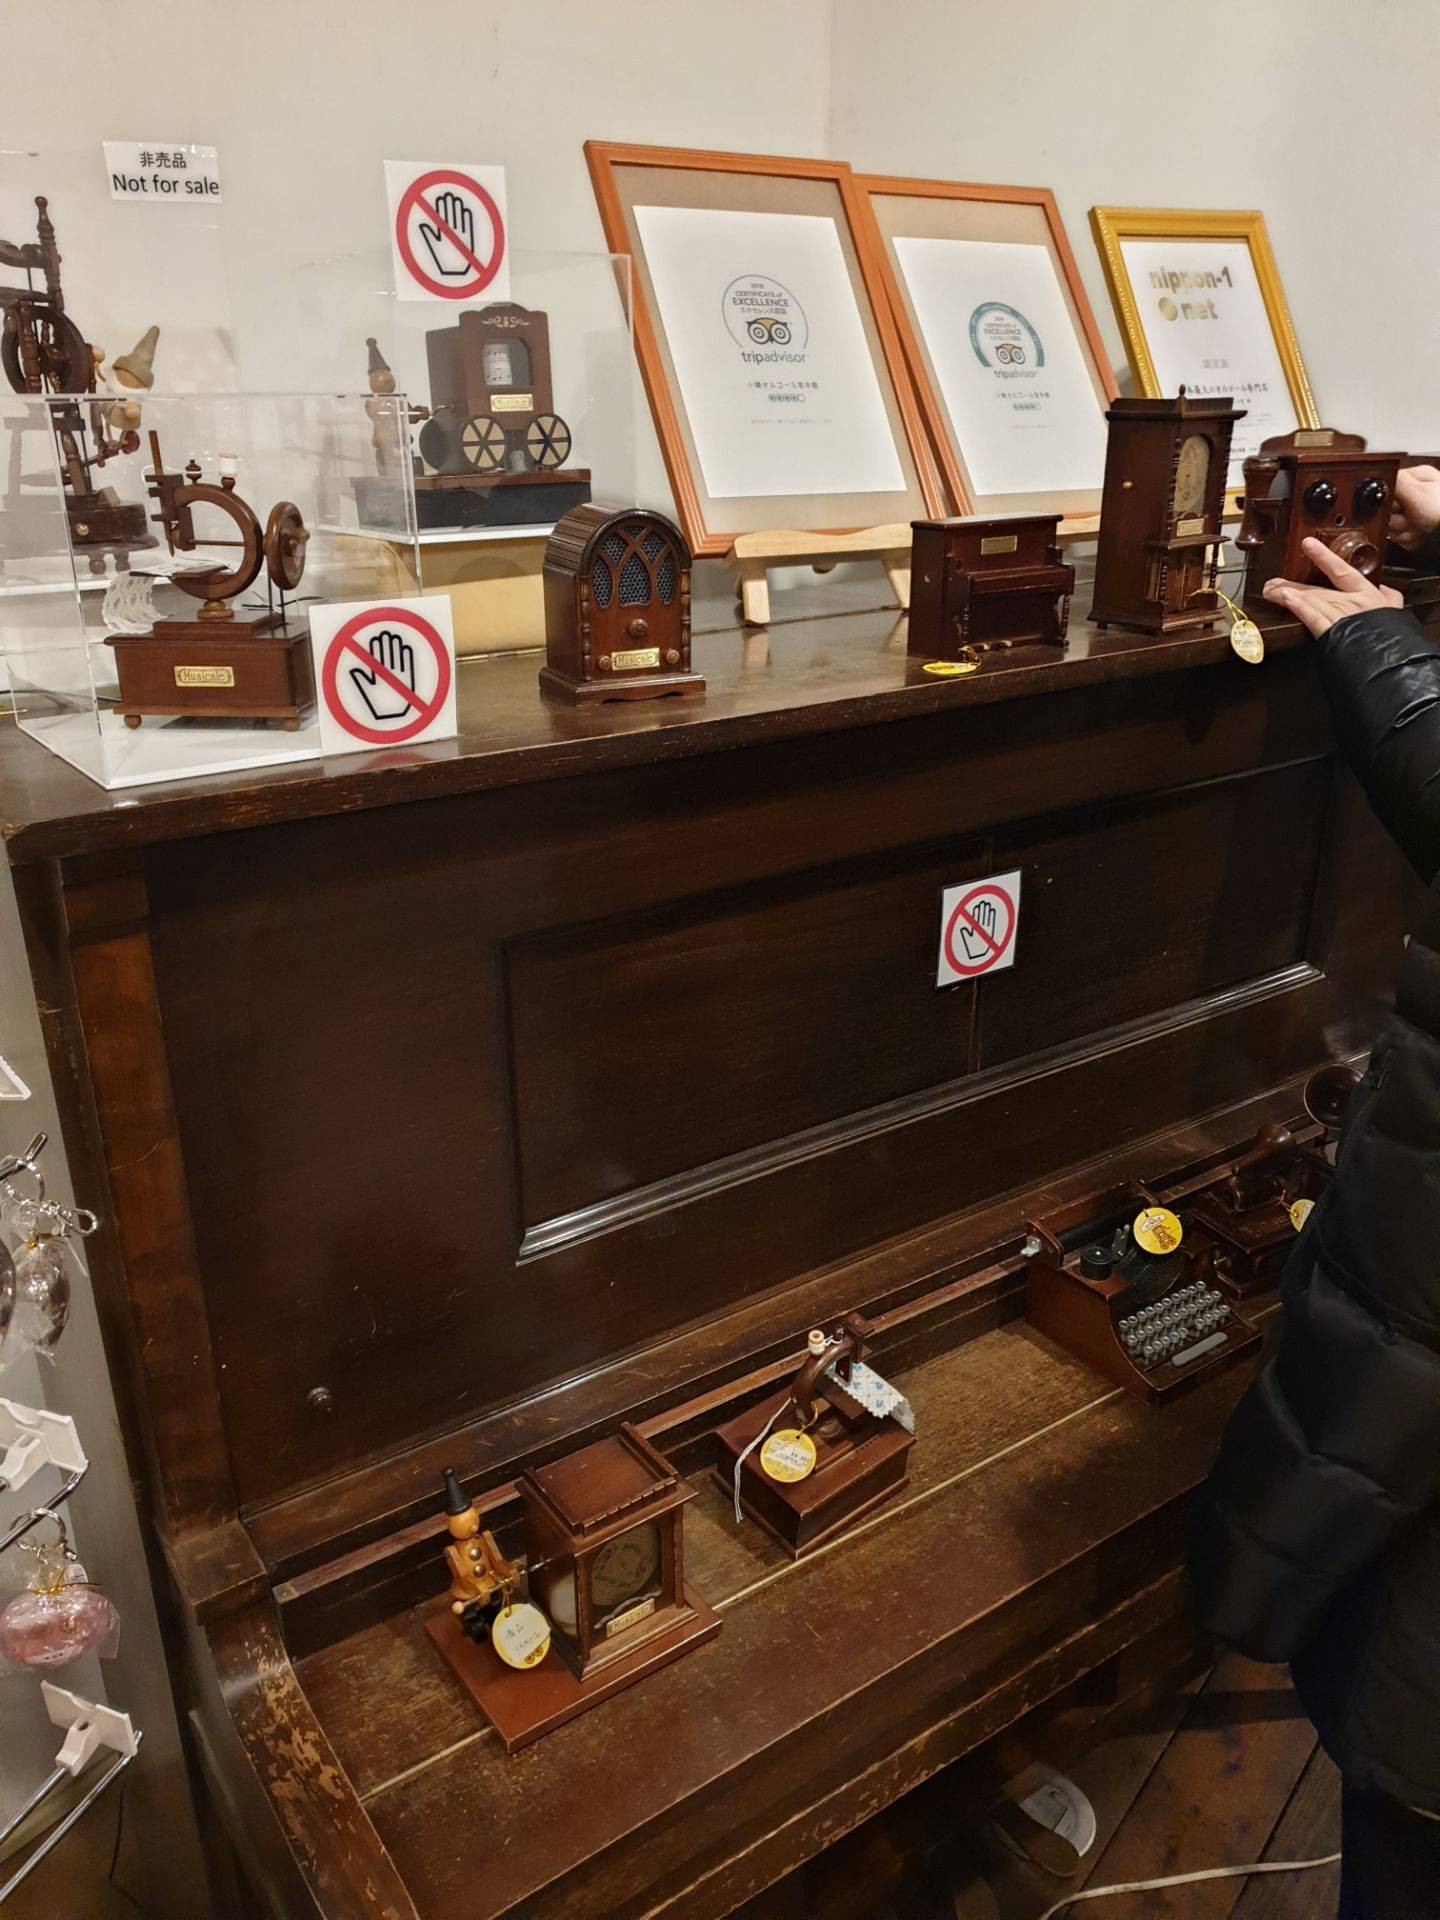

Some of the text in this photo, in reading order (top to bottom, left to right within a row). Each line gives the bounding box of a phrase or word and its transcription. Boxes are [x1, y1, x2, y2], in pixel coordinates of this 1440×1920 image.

[140, 151, 187, 169] 非売品
[112, 174, 219, 195] Not for sale
[732, 297, 790, 307] EXCELLENCE
[741, 351, 806, 365] tripadvisor
[993, 369, 1039, 380] tripadvisor
